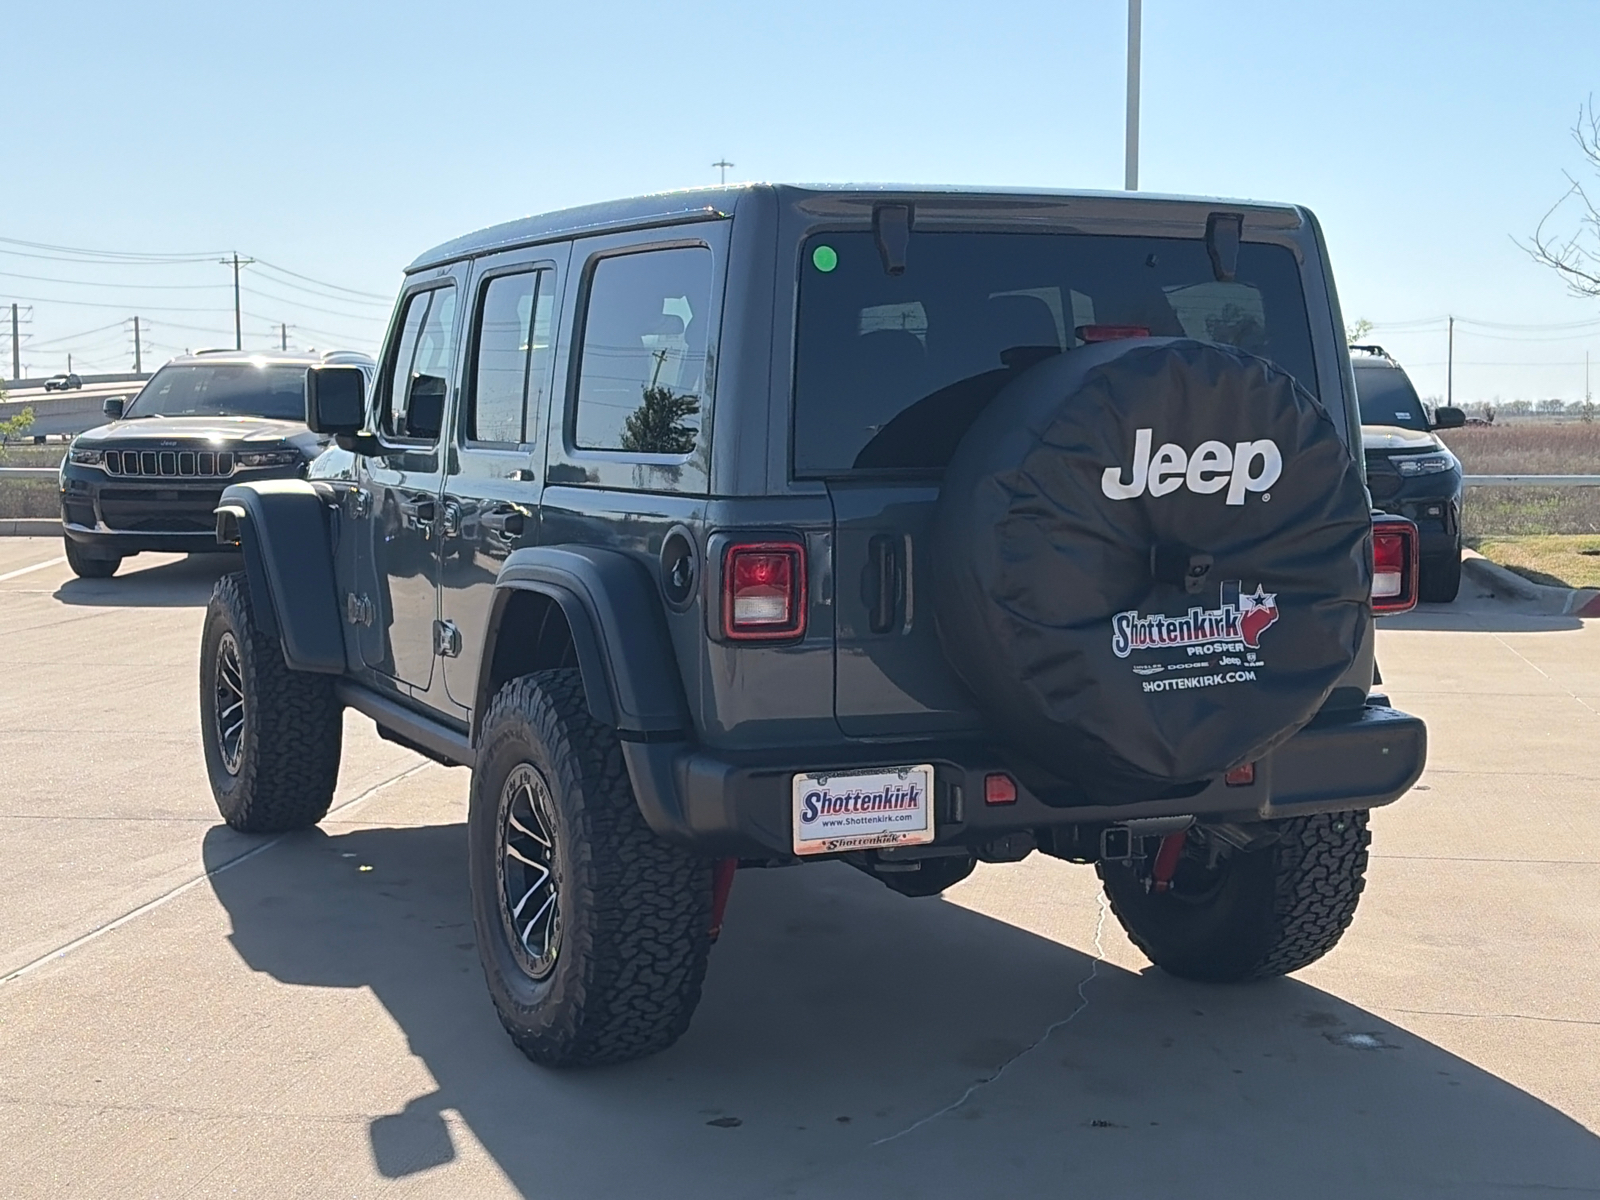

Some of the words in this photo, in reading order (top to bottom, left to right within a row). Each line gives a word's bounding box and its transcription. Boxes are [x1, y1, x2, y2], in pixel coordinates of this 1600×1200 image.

[1101, 428, 1283, 506] Jeep
[1113, 607, 1240, 656] Shottenkirk
[1186, 642, 1245, 656] PROSPER
[1167, 661, 1210, 670] DODGE
[1218, 655, 1242, 666] Jeep
[1142, 670, 1257, 692] SHOTTENKIRK.COM
[802, 784, 920, 823] Shottenkirk
[822, 813, 913, 827] www.Shottenkirk.com
